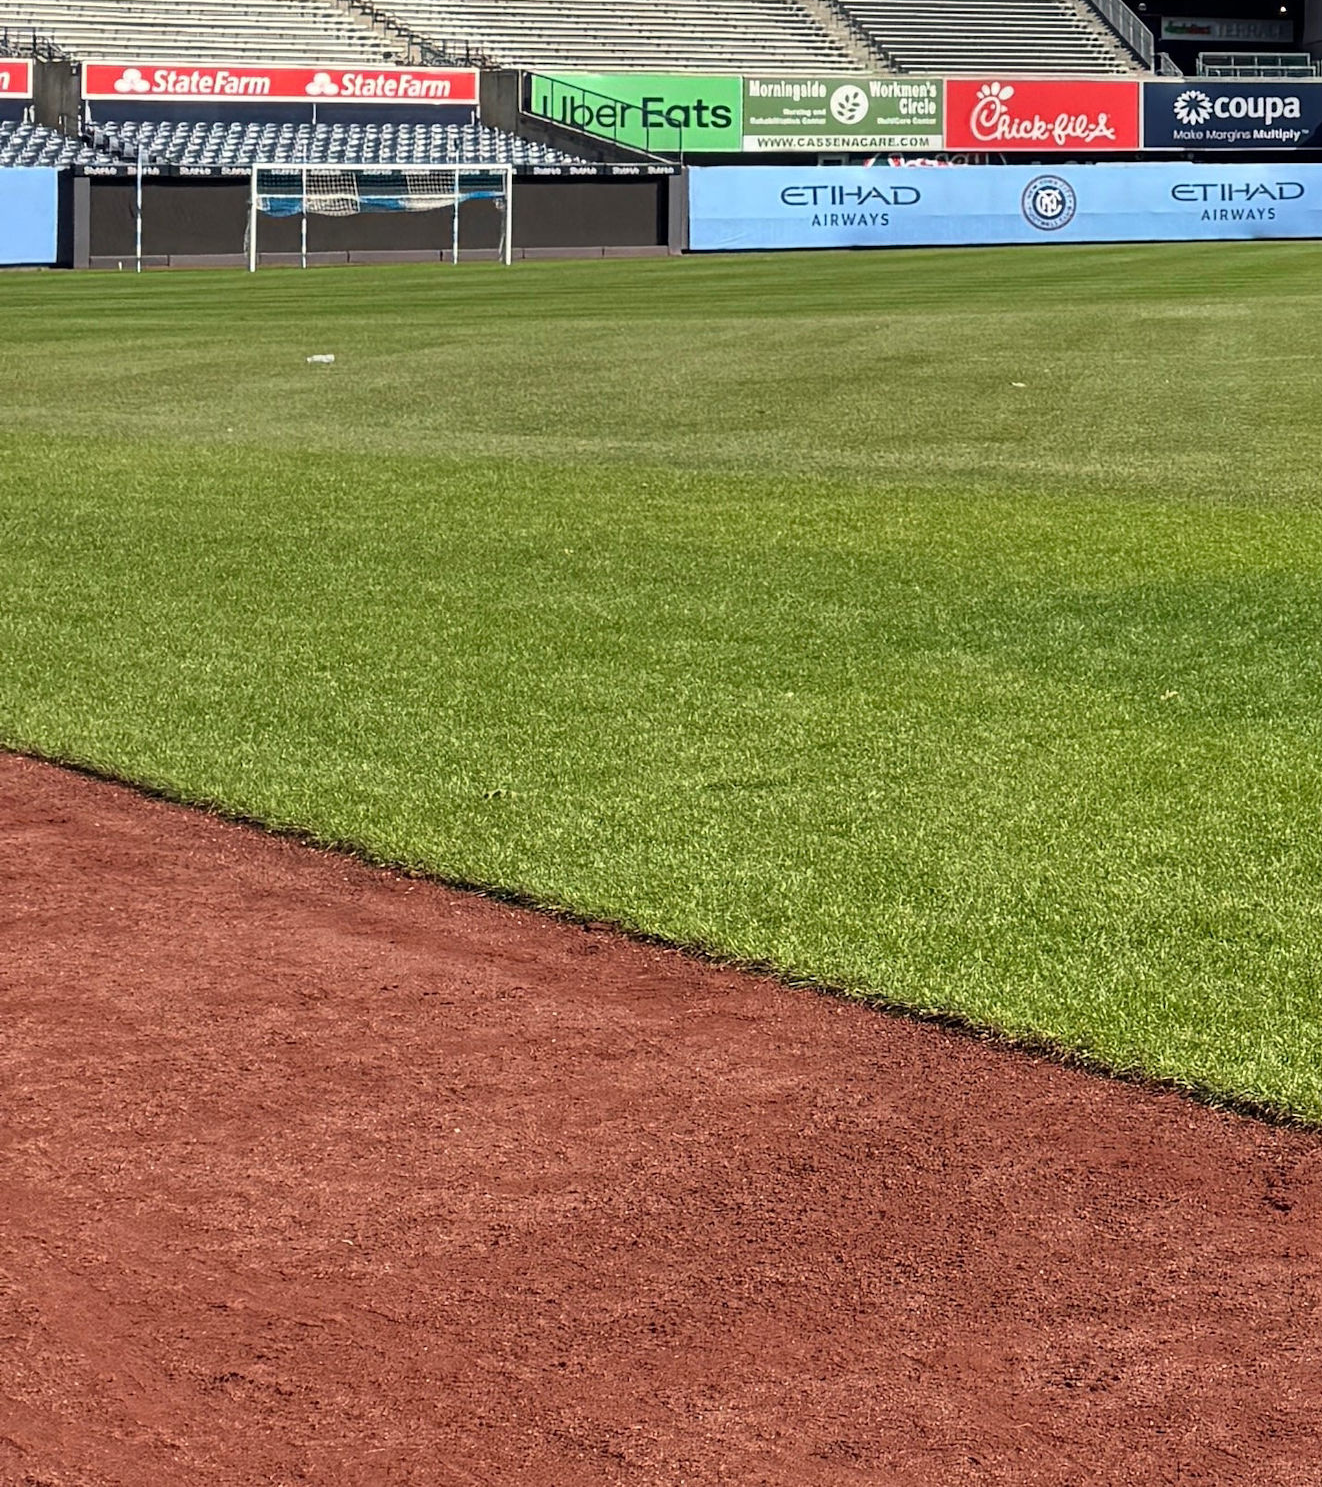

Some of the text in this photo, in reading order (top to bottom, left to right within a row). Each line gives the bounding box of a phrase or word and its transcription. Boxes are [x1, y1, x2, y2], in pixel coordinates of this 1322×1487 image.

[749, 80, 827, 101] Morningside
[869, 81, 937, 98] Workmen's
[641, 96, 732, 129] Eats
[899, 98, 937, 115] Circle
[969, 83, 1117, 143] Chick-fil-A
[1213, 96, 1301, 126] coupa
[757, 136, 930, 148] WWW.CASSENACARE.COM
[1173, 129, 1203, 140] Make
[1206, 129, 1252, 142] Margins
[781, 185, 921, 206] ETIHAD
[1171, 182, 1305, 201] ETIHAD
[811, 213, 890, 227] AIRWAYS
[1201, 207, 1276, 221] AIRWAYS
